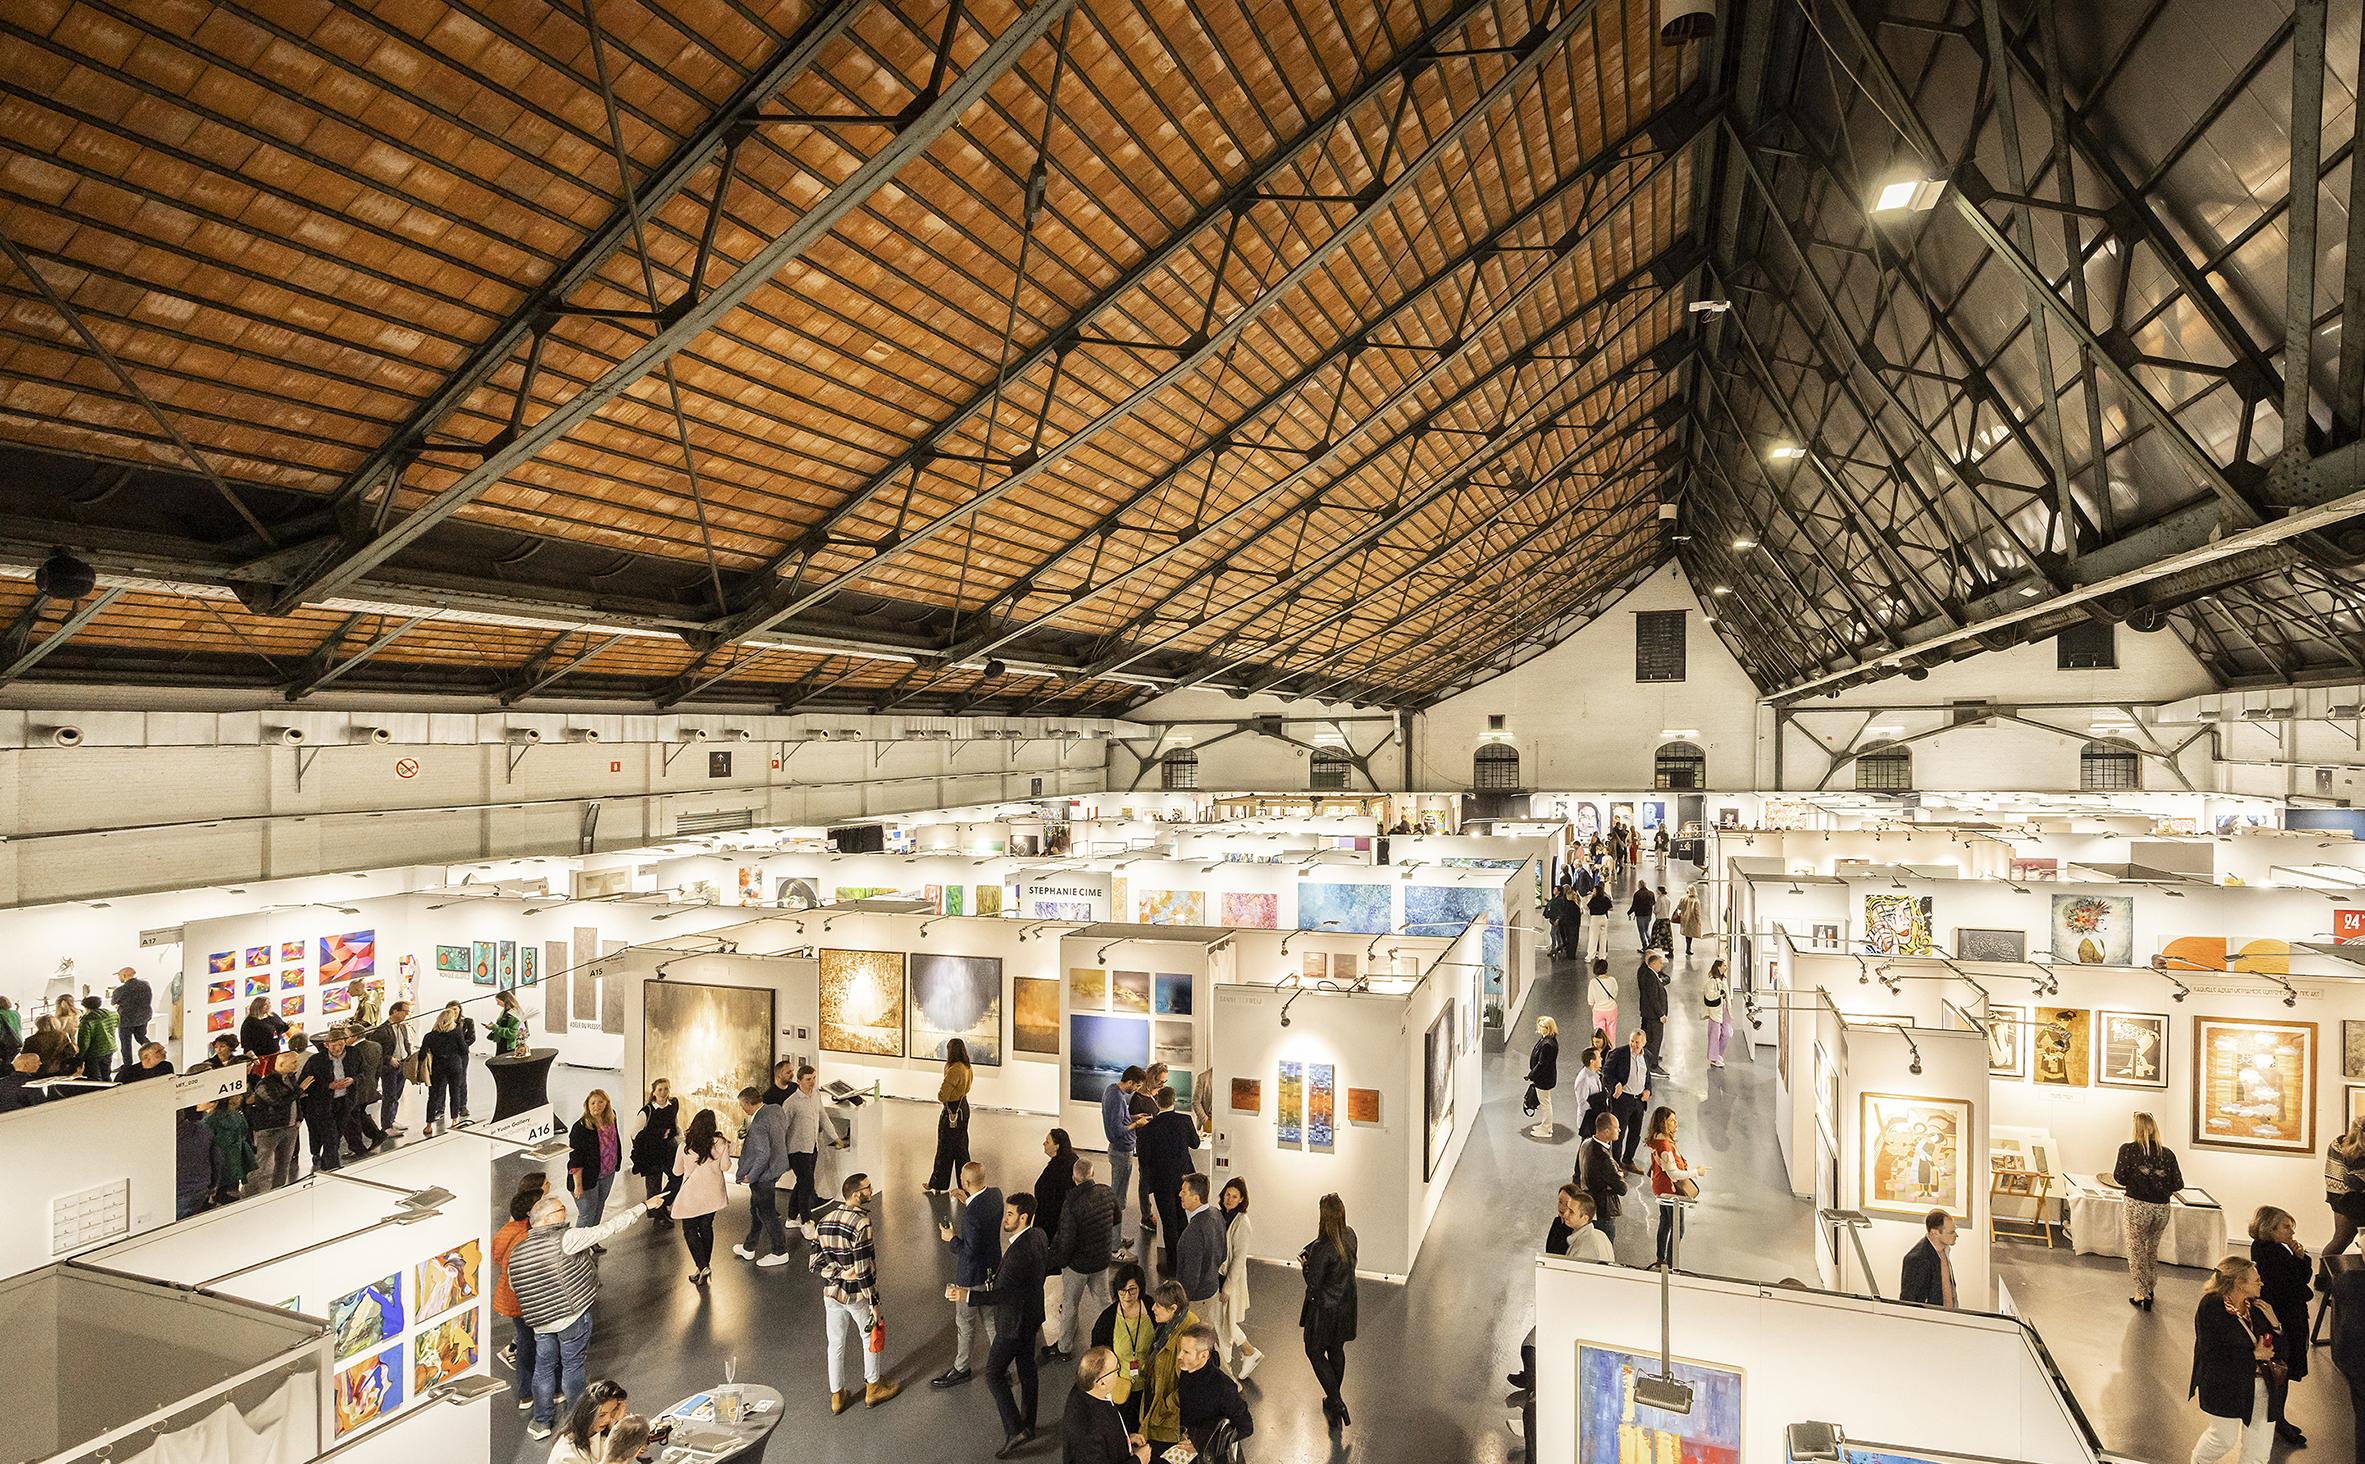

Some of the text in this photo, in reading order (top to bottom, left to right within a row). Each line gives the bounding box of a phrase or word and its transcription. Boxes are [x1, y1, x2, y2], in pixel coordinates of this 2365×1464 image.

[1029, 886, 1102, 897] STEPHANIE CIME
[142, 938, 156, 946] A17
[590, 967, 603, 977] A15
[218, 1080, 243, 1095] A18
[528, 1123, 550, 1141] A16
